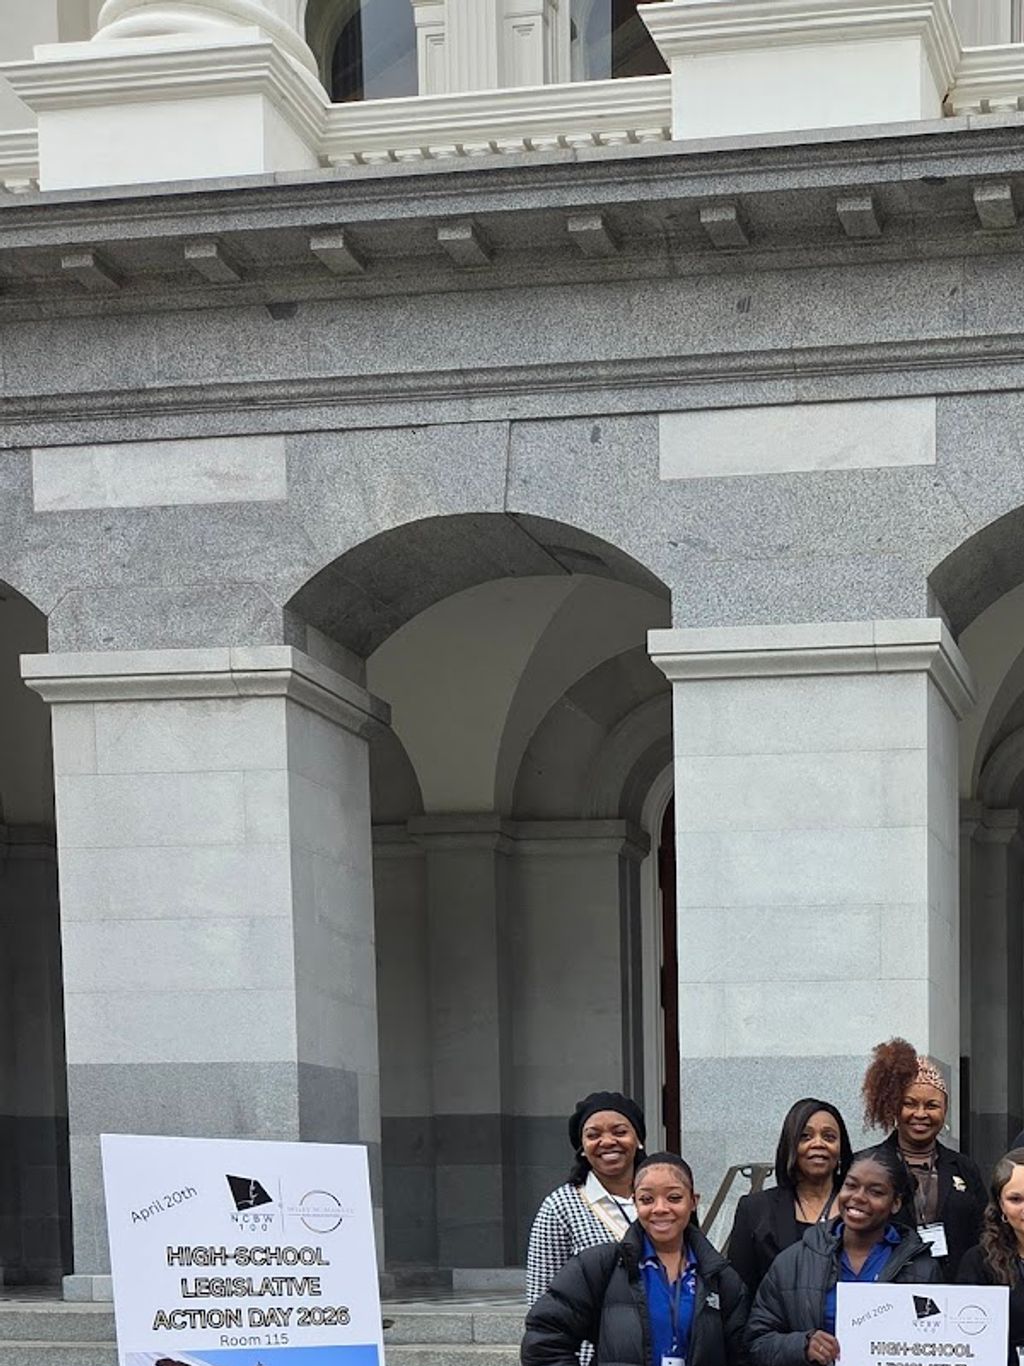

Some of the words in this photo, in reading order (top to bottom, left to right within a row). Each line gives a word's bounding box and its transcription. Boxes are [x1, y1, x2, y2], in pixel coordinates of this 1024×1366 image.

[130, 1203, 164, 1224] April
[164, 1185, 198, 1207] 20th
[167, 1246, 330, 1267] HIGH-SCHOOL
[181, 1276, 322, 1298] LEGISLATIVE
[152, 1308, 244, 1331] ACTION
[248, 1307, 296, 1328] DAY
[296, 1305, 351, 1327] 2026
[851, 1313, 872, 1327] April
[872, 1302, 894, 1317] 20th
[219, 1334, 261, 1346] Room
[264, 1333, 289, 1345] 115
[870, 1341, 975, 1358] HIGH-SCHOOL
